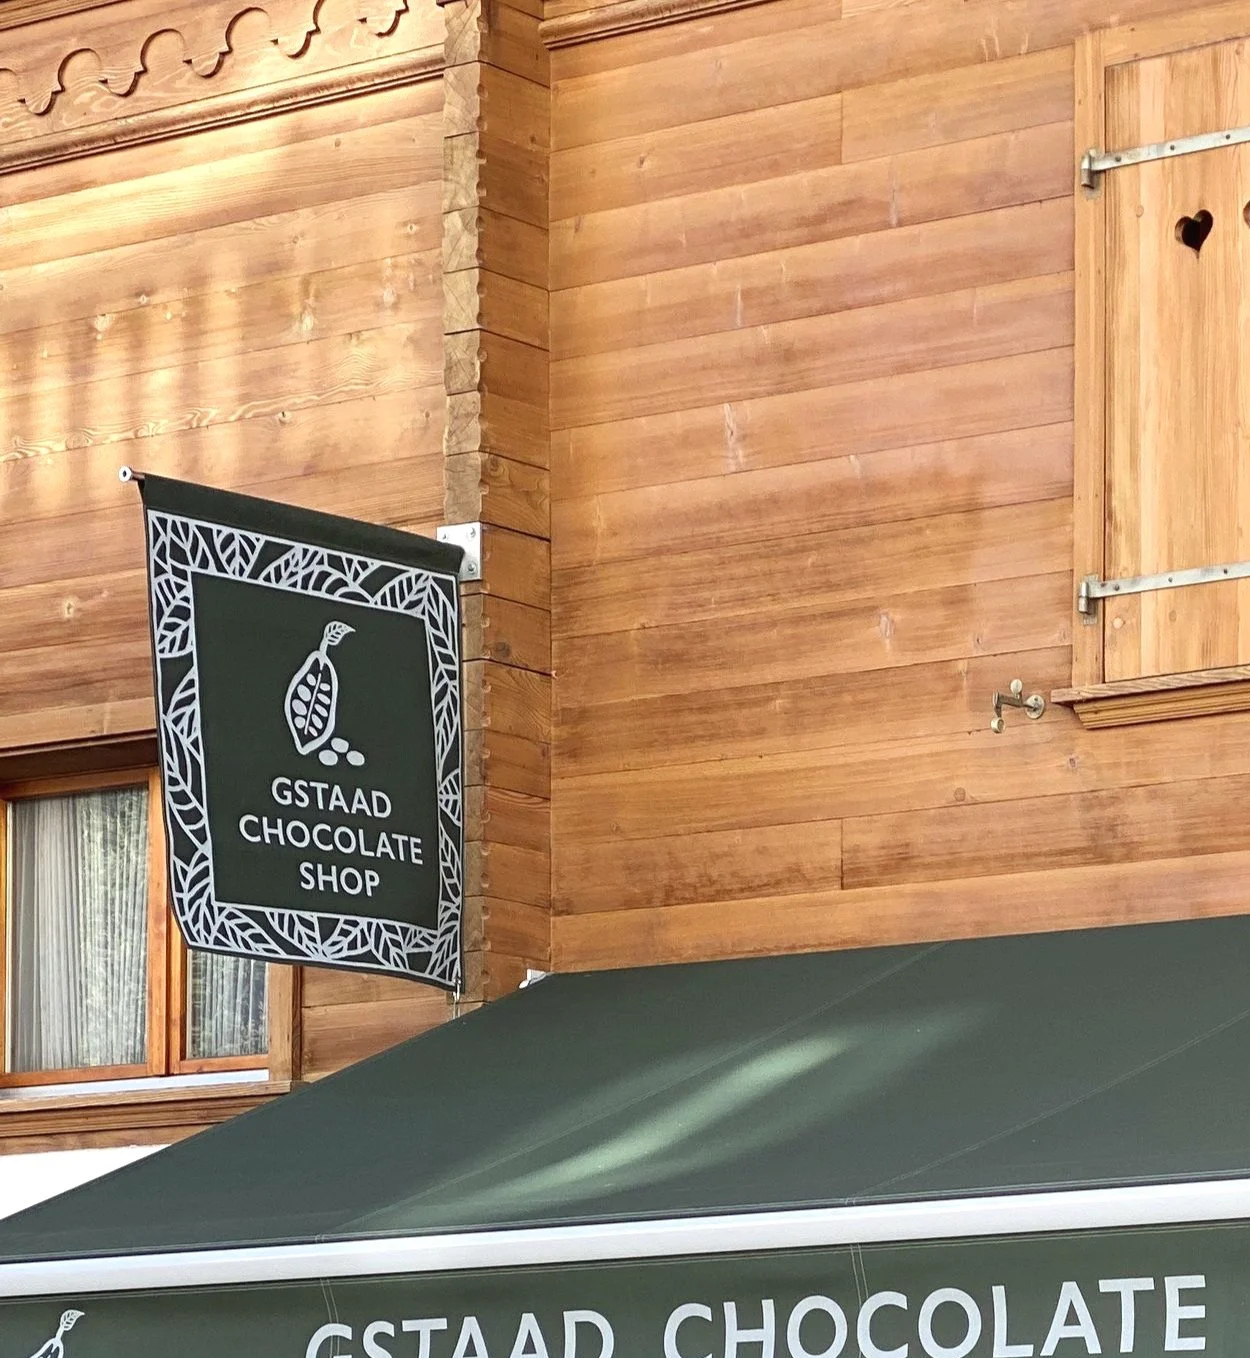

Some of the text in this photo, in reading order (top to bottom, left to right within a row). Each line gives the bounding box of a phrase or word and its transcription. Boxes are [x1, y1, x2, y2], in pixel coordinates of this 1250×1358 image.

[271, 776, 392, 819] GSTAAD
[239, 814, 424, 865] CHOCOLATE
[299, 861, 380, 897] SHOP
